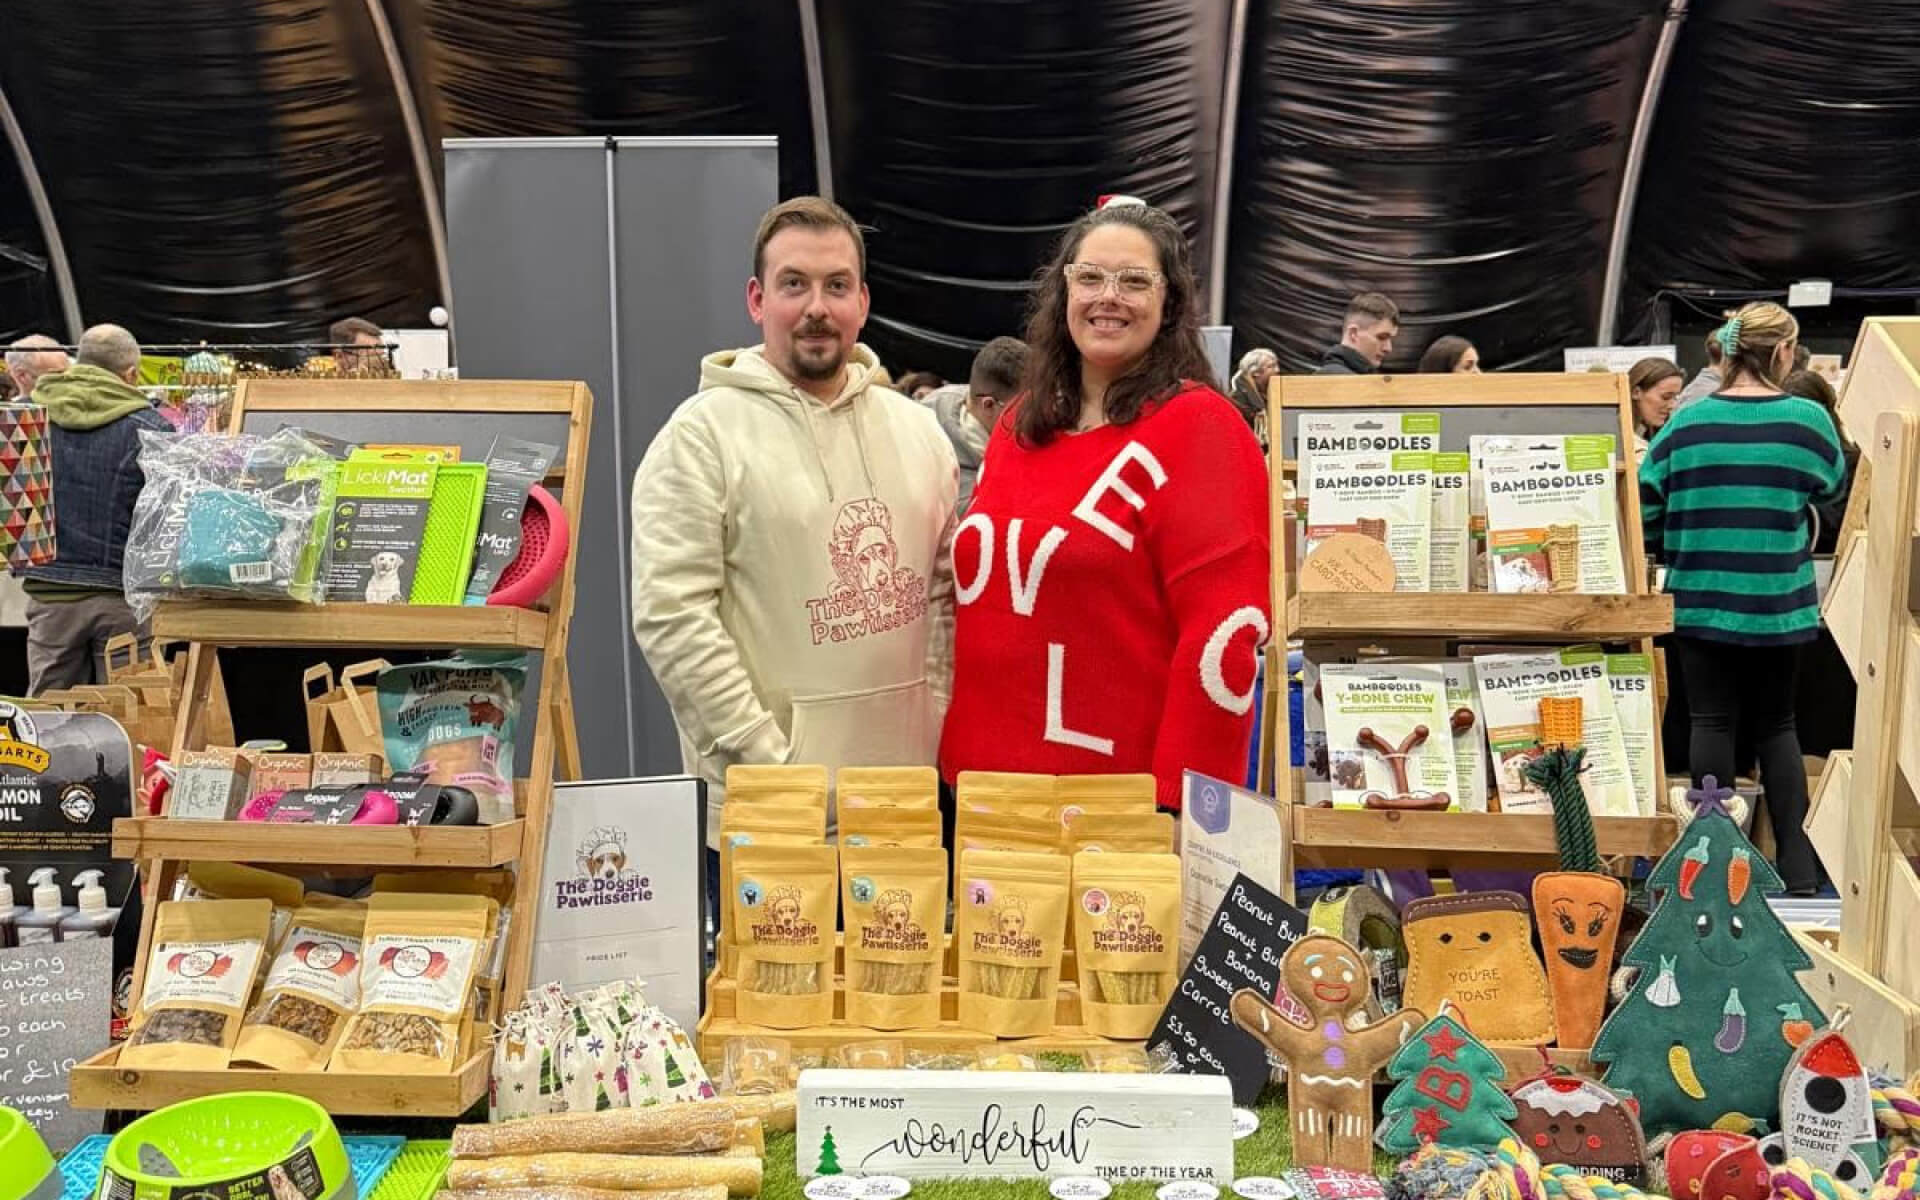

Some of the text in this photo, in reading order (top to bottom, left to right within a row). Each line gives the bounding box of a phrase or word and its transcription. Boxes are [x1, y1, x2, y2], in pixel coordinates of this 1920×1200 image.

[1307, 437, 1431, 450] BAMBOODLES
[344, 467, 429, 486] LickiMat
[1315, 474, 1426, 489] BAMBOODLES
[1431, 476, 1462, 489] LES
[1490, 473, 1605, 493] BAMBOODLES
[806, 596, 857, 622] The
[1348, 683, 1422, 691] BAMBOODLES
[1336, 693, 1435, 704] Y-BONE CHEW
[183, 753, 230, 768] Organic
[258, 756, 305, 773] Organic
[319, 755, 365, 769] Organic
[555, 876, 649, 895] The Doggie
[556, 889, 653, 909] Pawtisserie
[1231, 884, 1274, 926] Peanut
[776, 924, 817, 937] Doggie
[861, 926, 927, 942] The Doggie
[1092, 930, 1163, 944] The Doggie
[1217, 912, 1257, 953] Peanut
[861, 938, 929, 950] Pawtisserie
[973, 931, 1042, 948] The Doggie
[1093, 941, 1164, 953] Pawtisserie
[610, 952, 628, 960] LIST
[1224, 949, 1271, 996] Banana
[1448, 968, 1501, 983] YOU'RE
[20, 987, 85, 1006] treats
[1180, 978, 1230, 1025] Carrot
[1456, 988, 1500, 1001] TOAST
[18, 1018, 67, 1034] each
[1416, 1066, 1472, 1112] B
[815, 1096, 904, 1109] IT'S THE MOST
[1796, 1112, 1843, 1129] IT'S NOT
[860, 1102, 1100, 1172] wonderful
[1792, 1135, 1840, 1153] SCIENCE
[1095, 1166, 1214, 1179] TIME OF THE YEAR
